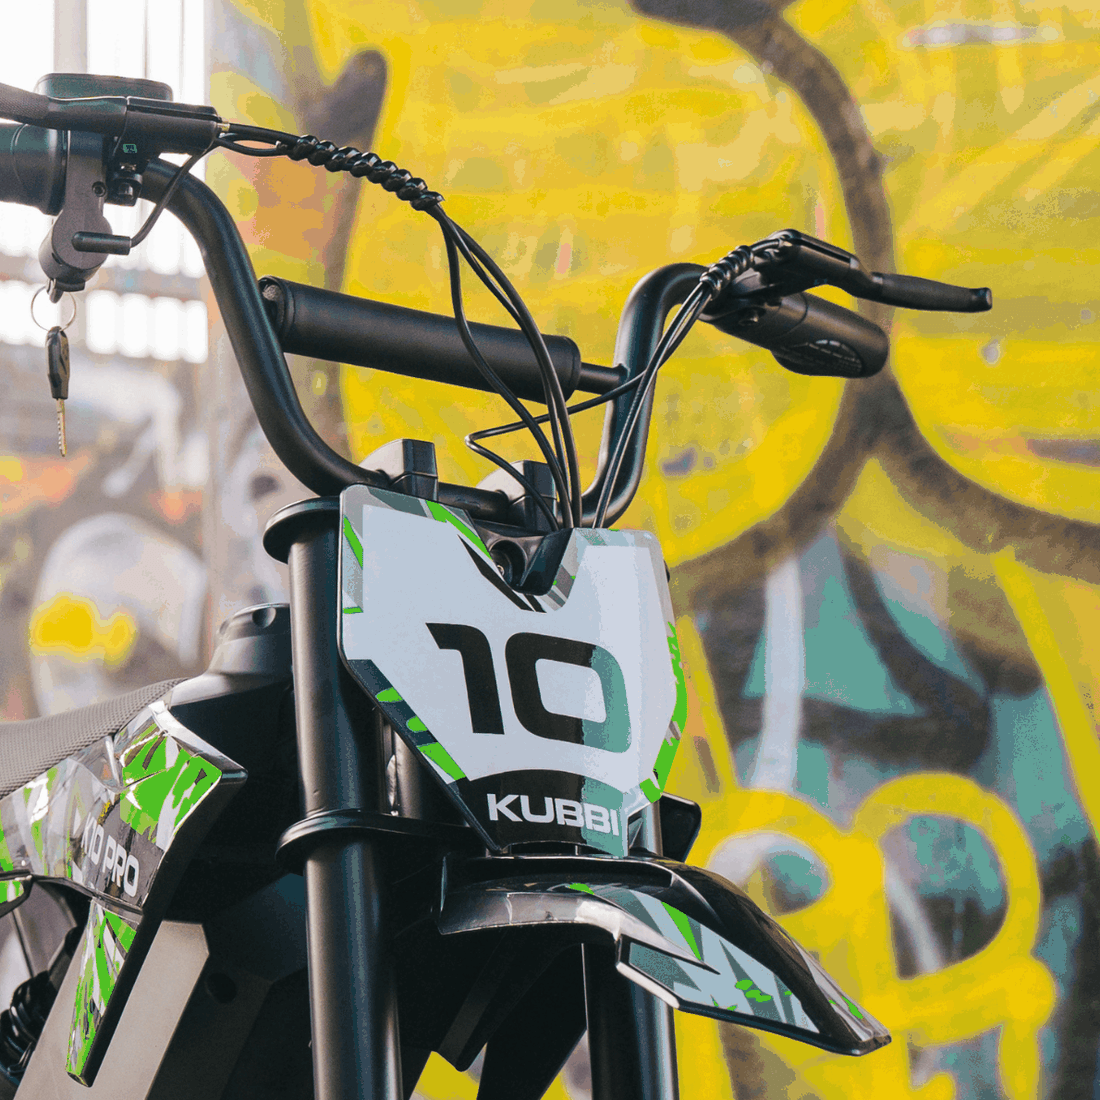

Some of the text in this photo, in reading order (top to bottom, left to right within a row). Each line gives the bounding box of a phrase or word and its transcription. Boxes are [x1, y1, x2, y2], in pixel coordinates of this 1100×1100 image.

[426, 622, 632, 754] 10
[486, 793, 619, 837] KUBBI
[102, 834, 139, 898] PRO
